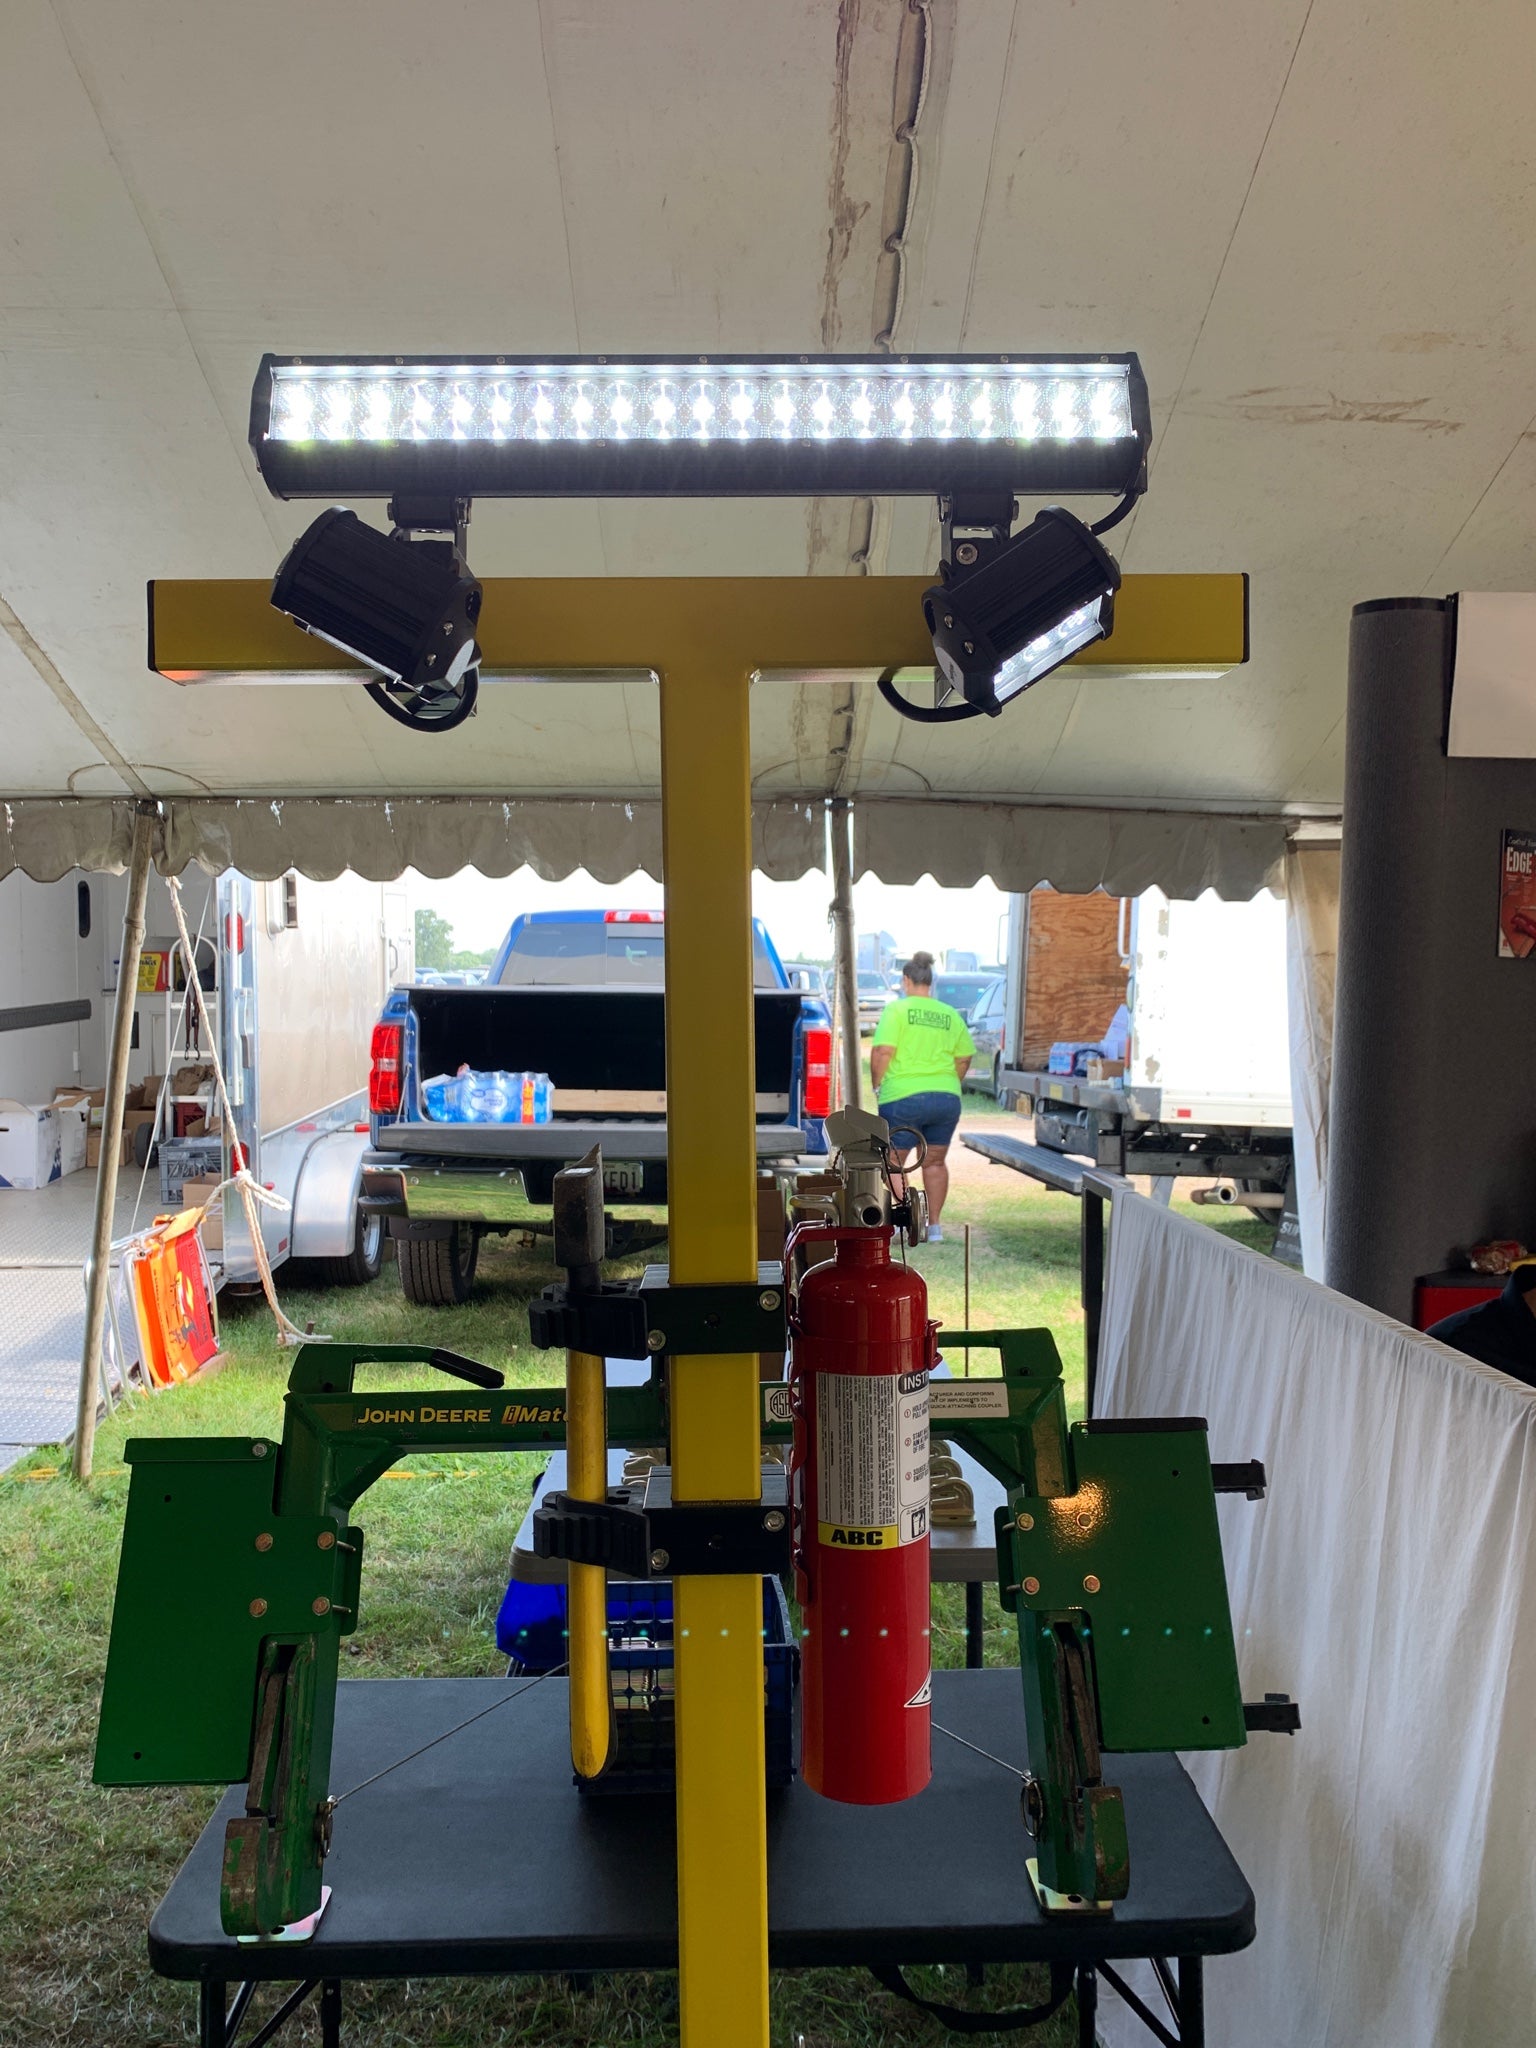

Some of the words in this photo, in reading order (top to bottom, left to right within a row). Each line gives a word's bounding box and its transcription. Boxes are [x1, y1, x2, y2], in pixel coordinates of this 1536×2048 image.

[1506, 846, 1533, 874] EDGE
[908, 1009, 922, 1024] GET
[357, 1407, 415, 1424] JOHN
[420, 1407, 491, 1423] DEERE
[831, 1529, 883, 1546] ABC
